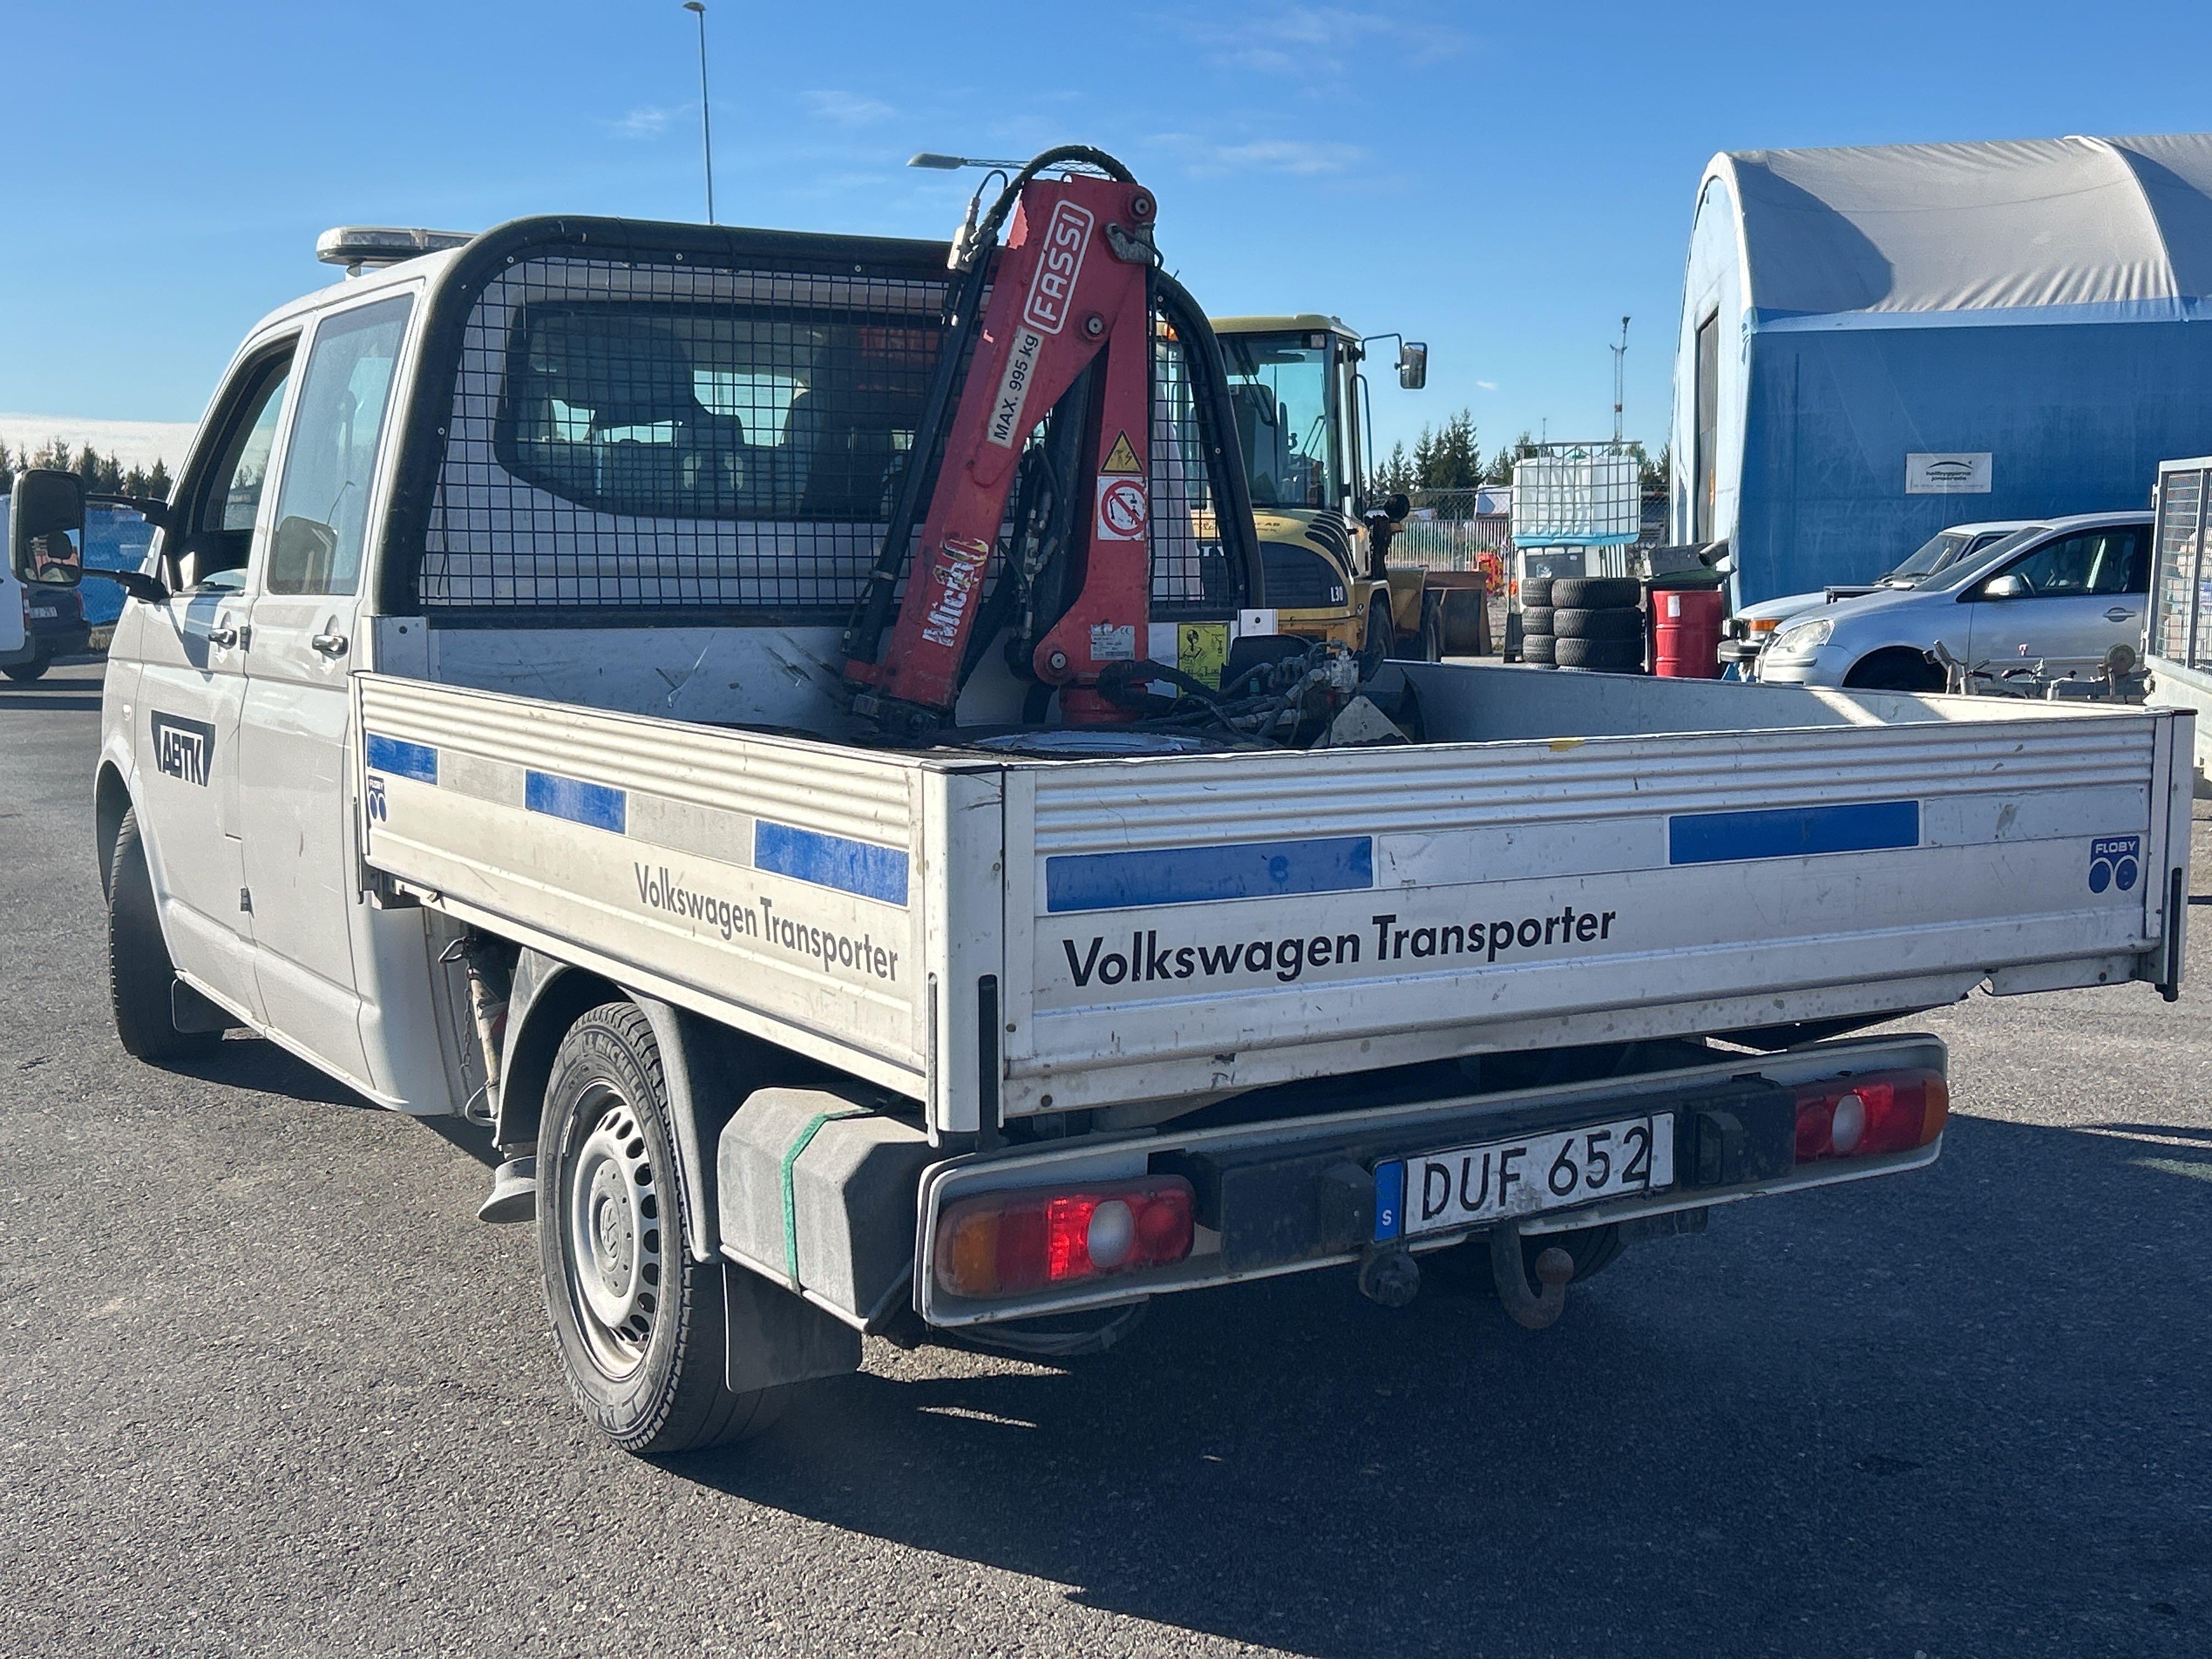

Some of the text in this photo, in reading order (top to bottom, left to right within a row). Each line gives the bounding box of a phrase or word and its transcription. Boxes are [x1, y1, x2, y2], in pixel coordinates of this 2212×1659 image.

[1033, 212, 1085, 322] FASSI
[994, 335, 1039, 441] MAX. 995 kg
[162, 730, 203, 786] ABTK
[2095, 840, 2136, 854] FLOBY
[634, 862, 899, 981] Volkswagen Transporter
[1062, 905, 1616, 988] Volkswagen Transporter
[1381, 1209, 1392, 1226] S
[1422, 1126, 1649, 1221] DUF 652
